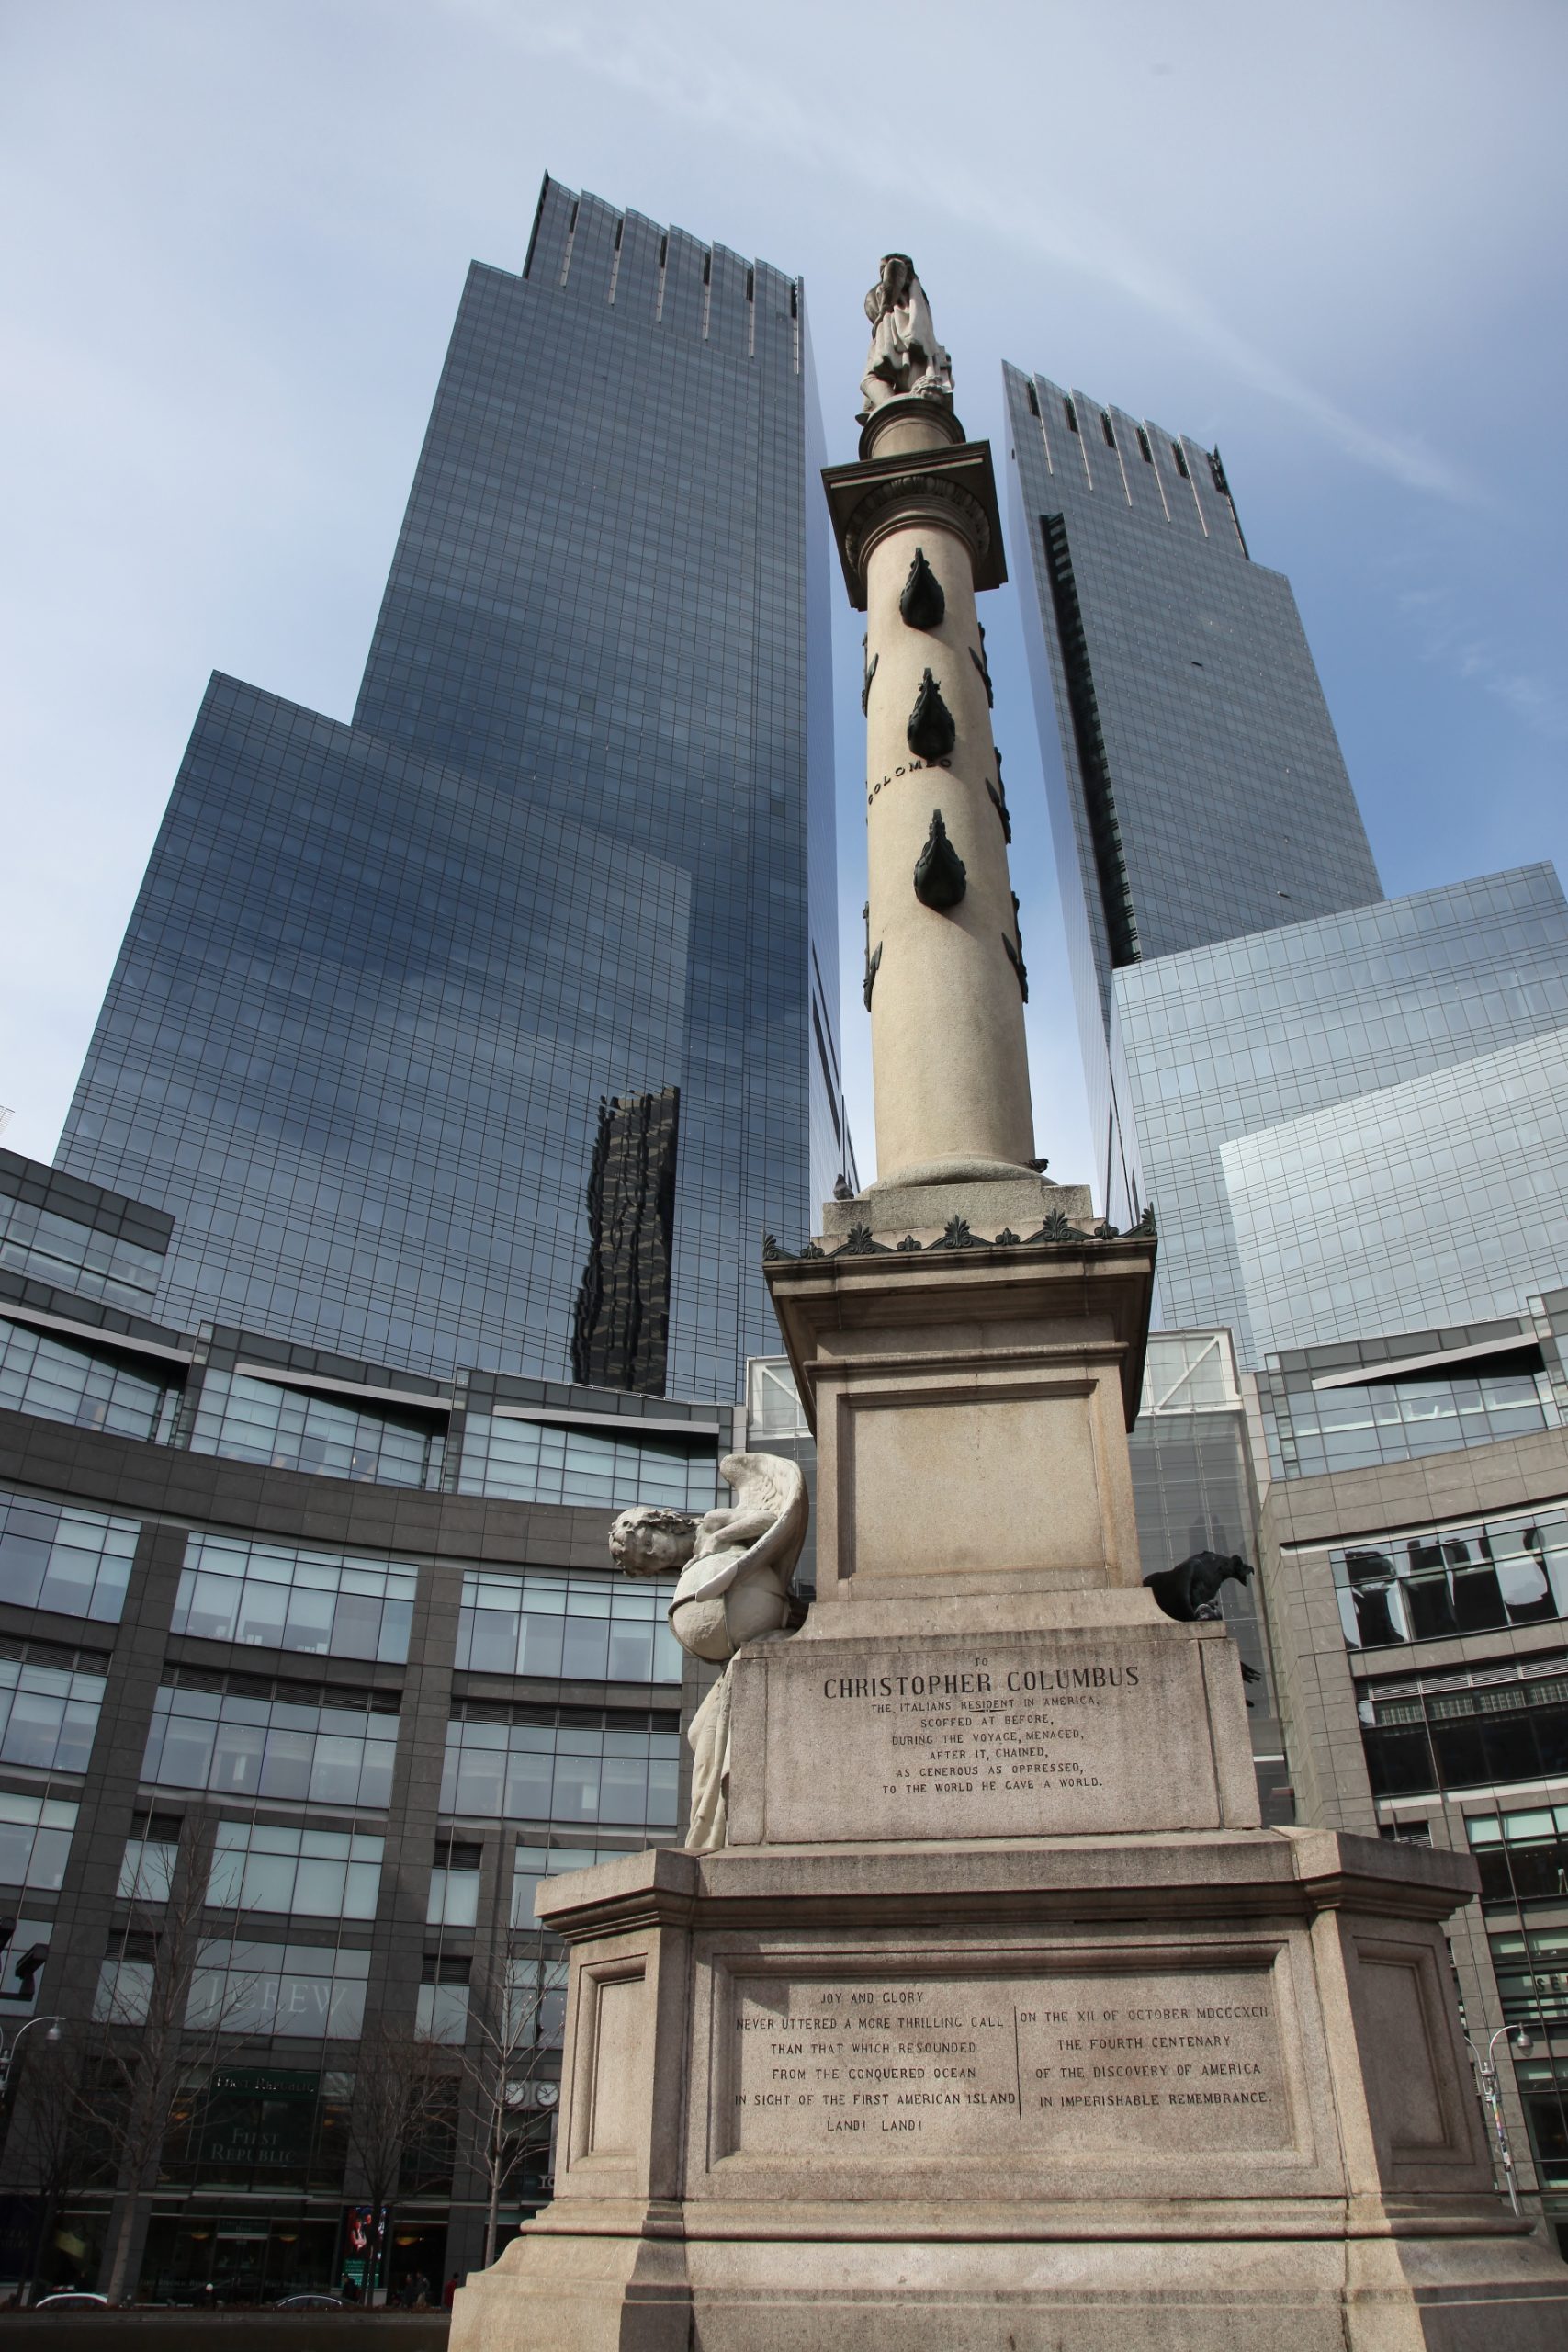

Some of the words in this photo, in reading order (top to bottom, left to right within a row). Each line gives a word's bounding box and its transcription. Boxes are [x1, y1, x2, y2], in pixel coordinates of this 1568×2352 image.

[975, 1657, 987, 1667] TO
[824, 1673, 991, 1699] CHRISTOPHER
[1007, 1666, 1140, 1691] COLUMBUS
[899, 1702, 952, 1712] ITALIANS
[961, 1699, 1014, 1710] RESIDENT
[1024, 1698, 1034, 1707] IN
[920, 1717, 972, 1728] SCOFFED
[981, 1717, 995, 1725] AT
[1005, 1714, 1054, 1725] BEFORE,
[892, 1735, 933, 1746] DURING
[942, 1734, 964, 1744] THE
[973, 1732, 1021, 1743] VOYAGE,
[1025, 1729, 1084, 1741] MENACED,
[930, 1749, 966, 1759] AFTER
[975, 1749, 989, 1761] IT,
[995, 1747, 1048, 1758] CHAINED,
[897, 1769, 910, 1778] AS
[919, 1766, 978, 1777] GENEROUS
[988, 1765, 1002, 1774] AS
[1011, 1763, 1084, 1774] OPPRESSED,
[883, 1785, 896, 1794] TO
[907, 1784, 927, 1793] THE
[935, 1782, 973, 1792] WORLD
[981, 1781, 996, 1791] HE
[1005, 1780, 1034, 1790] GAVE
[1043, 1779, 1050, 1788] A
[1059, 1777, 1102, 1787] WORLD.
[232, 1979, 347, 2015] CREW
[820, 1993, 842, 2004] JOY
[851, 1993, 874, 2004] AND
[883, 1992, 924, 2003] GLORY
[1020, 2012, 1036, 2023] ON
[1045, 2011, 1068, 2022] THE
[1078, 2011, 1094, 2021] XII
[1103, 2010, 1118, 2020] OF
[1128, 2008, 1189, 2020] OCTOBER
[1196, 2007, 1269, 2018] MDCCCXCII
[736, 2018, 774, 2030] NEVER
[782, 2018, 837, 2030] UTTERED
[845, 2018, 852, 2029] A
[858, 2018, 890, 2029] MORE
[898, 2017, 963, 2029] THRILLING
[971, 2017, 1004, 2028] CALL
[772, 2044, 802, 2054] THAN
[811, 2043, 843, 2054] THAT
[852, 2043, 890, 2053] WHICH
[898, 2042, 976, 2053] RESOUNDED
[1057, 2039, 1081, 2051] THE
[1090, 2038, 1143, 2049] FOURTH
[1152, 2035, 1230, 2048] CENTENARY
[773, 2069, 806, 2080] FROM
[816, 2069, 839, 2079] THE
[849, 2068, 925, 2082] CONQUERED
[934, 2068, 976, 2078] OCEAN
[1036, 2068, 1050, 2079] OF
[1060, 2067, 1084, 2078] THE
[1093, 2065, 1168, 2077] DISCOVERY
[1177, 2064, 1192, 2075] OF
[1201, 2063, 1261, 2075] AMERICA
[735, 2095, 746, 2106] IN
[755, 2095, 790, 2106] SIGHT
[799, 2095, 812, 2105] OF
[824, 2095, 845, 2105] THE
[853, 2095, 889, 2105] FIRST
[897, 2094, 960, 2104] AMERICAN
[967, 2093, 1015, 2104] ISLAND
[1040, 2097, 1052, 2107] IN
[1061, 2095, 1160, 2107] IMPERISHABLE
[1169, 2092, 1271, 2105] REMEMBRANCE.
[827, 2120, 866, 2132] LAND!
[882, 2120, 922, 2131] LAND!
